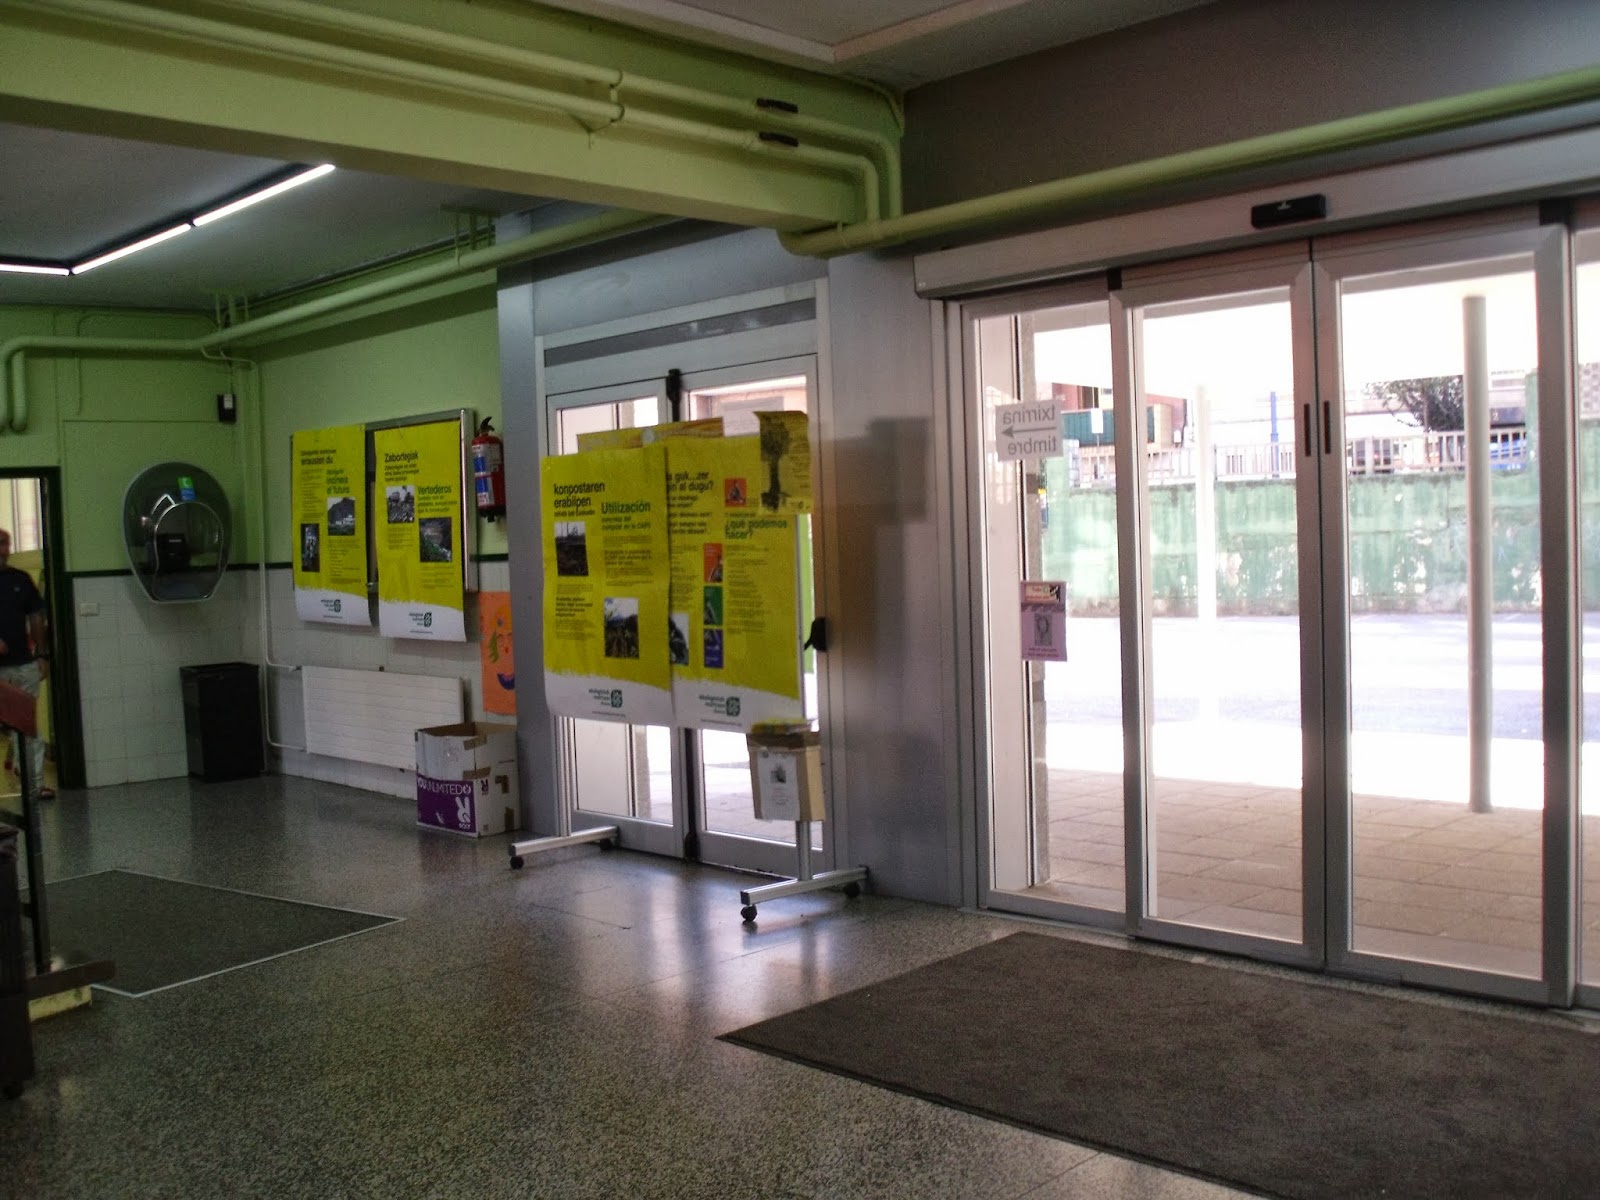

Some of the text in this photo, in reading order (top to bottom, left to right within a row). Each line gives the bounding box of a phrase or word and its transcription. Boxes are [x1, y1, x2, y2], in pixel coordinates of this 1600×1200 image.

[553, 482, 606, 495] konpostaren
[554, 496, 591, 510] erabilpen
[601, 500, 651, 514] Utilización
